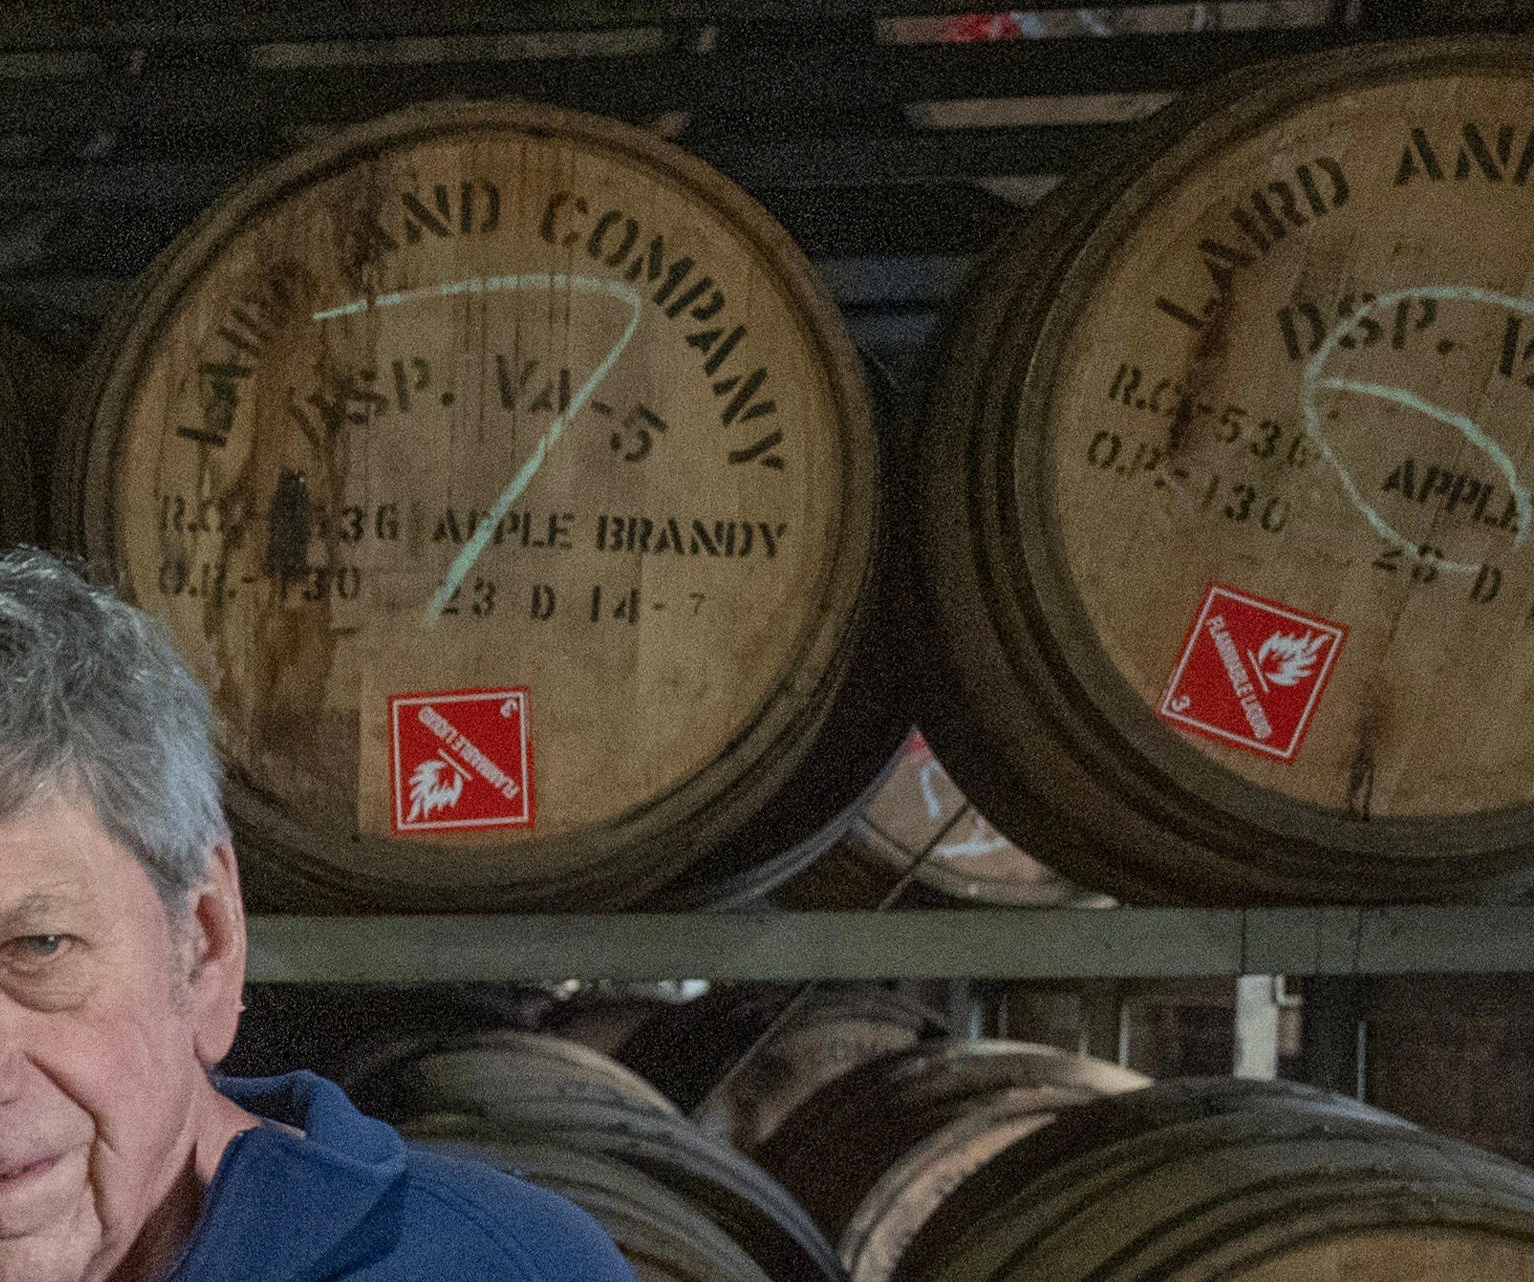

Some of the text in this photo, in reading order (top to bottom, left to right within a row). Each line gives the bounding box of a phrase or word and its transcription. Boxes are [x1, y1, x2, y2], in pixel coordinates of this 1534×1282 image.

[1155, 156, 1351, 332] LAIRD
[540, 191, 789, 474] COMPANY
[312, 273, 643, 630] 7
[594, 511, 789, 561] BRANDY
[1469, 563, 1504, 604] D
[530, 583, 557, 623] D
[1206, 614, 1274, 740] FLAMMABLE LIQUID
